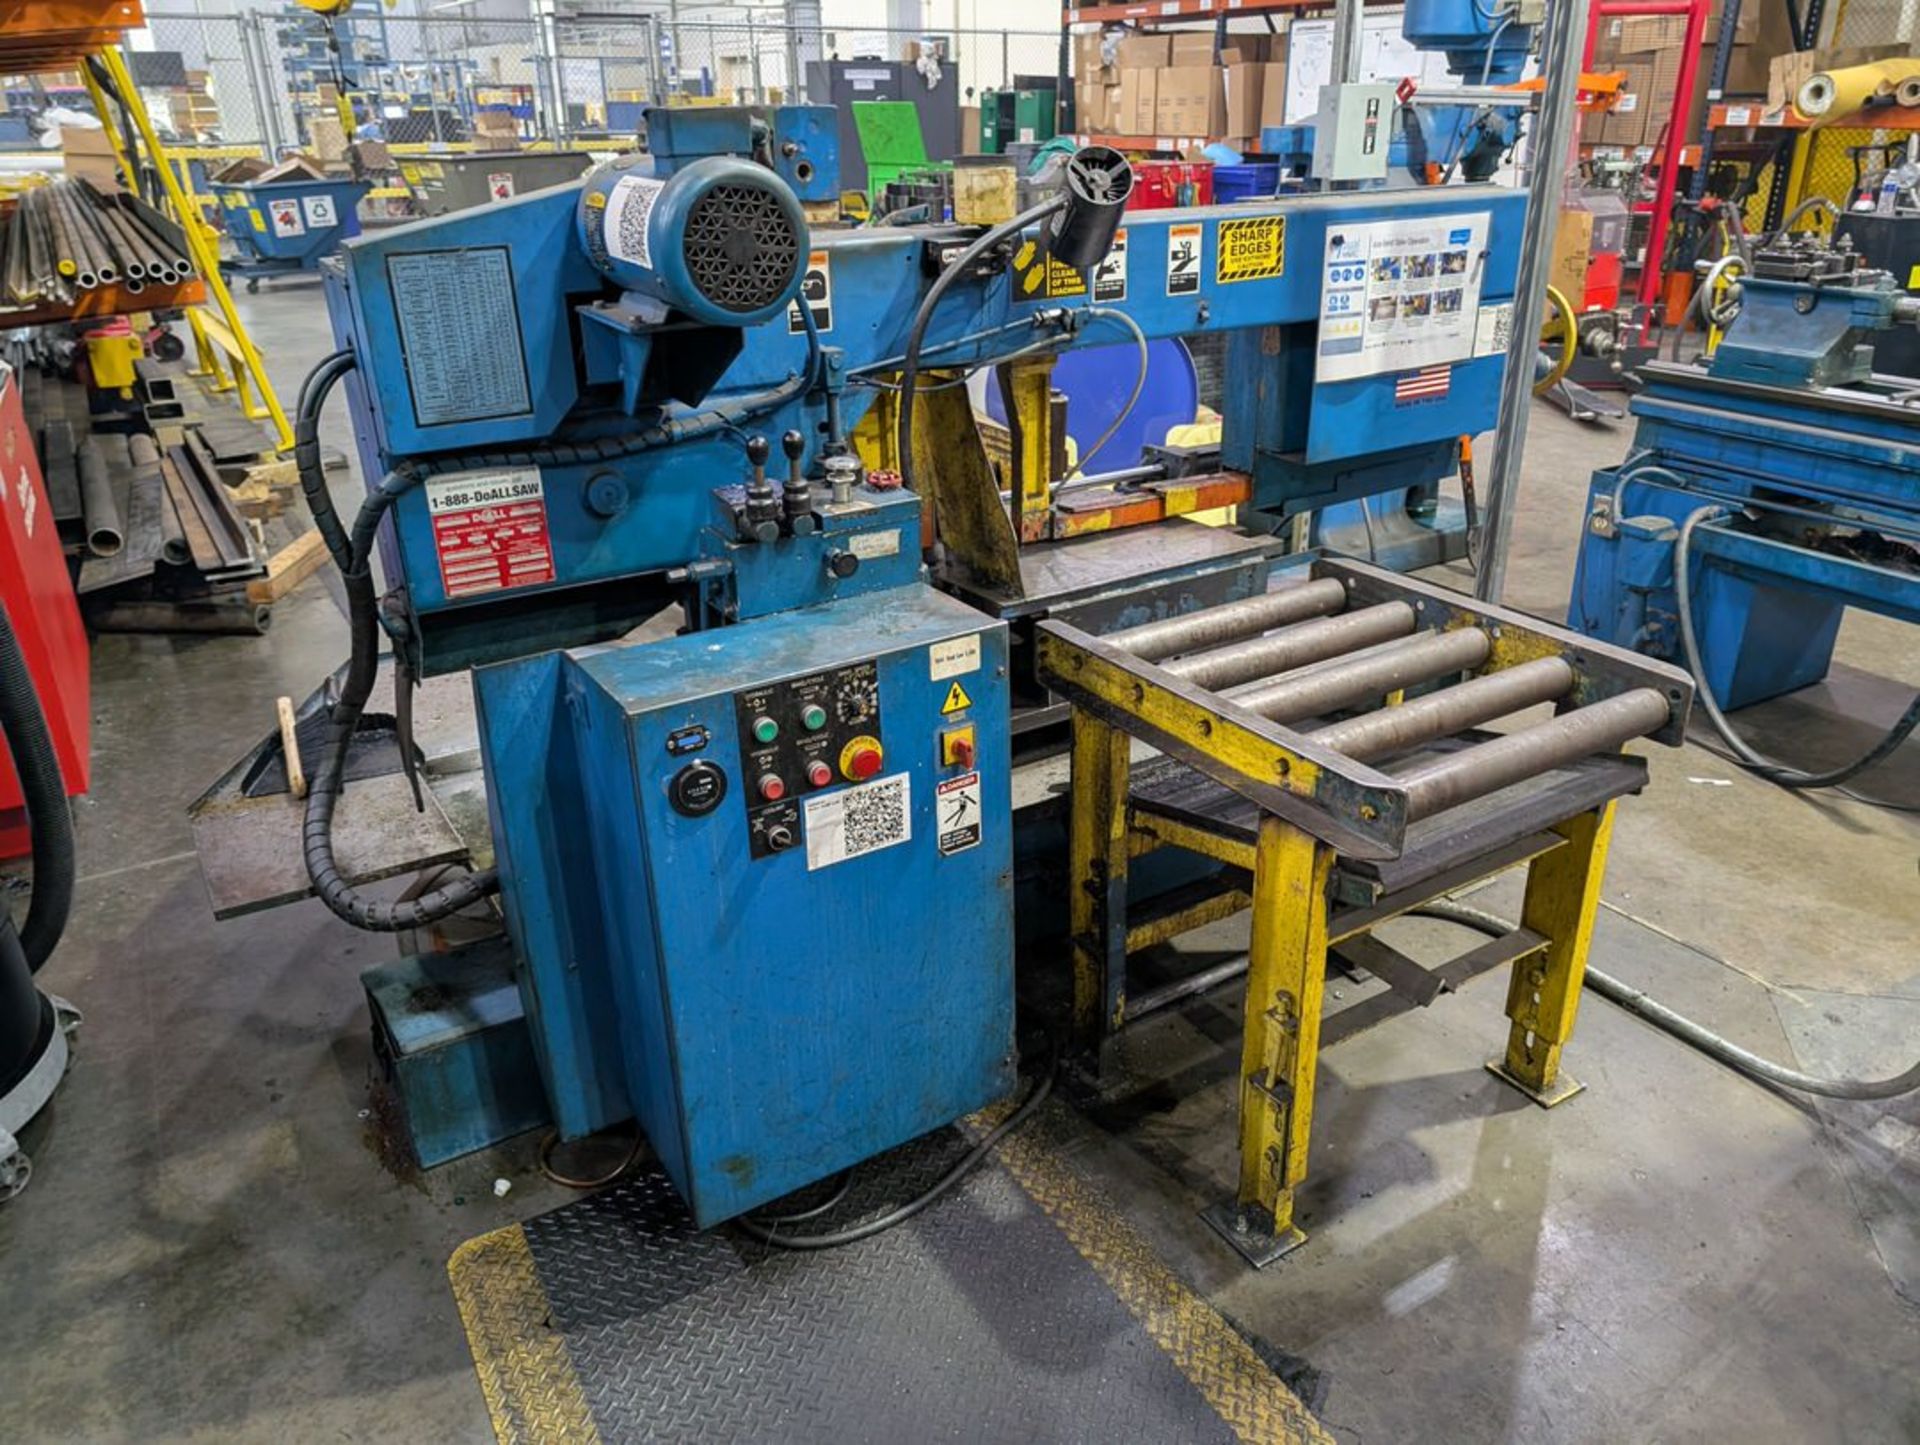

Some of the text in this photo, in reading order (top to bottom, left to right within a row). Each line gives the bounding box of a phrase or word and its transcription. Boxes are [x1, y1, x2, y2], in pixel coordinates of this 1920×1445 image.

[1231, 228, 1273, 243] SHARP
[1231, 240, 1272, 256] EDGES
[1052, 268, 1076, 278] CLEAR
[1052, 279, 1061, 287] OF
[1052, 285, 1085, 295] MACHINE
[432, 482, 540, 508] 1-888-DoALLSAW
